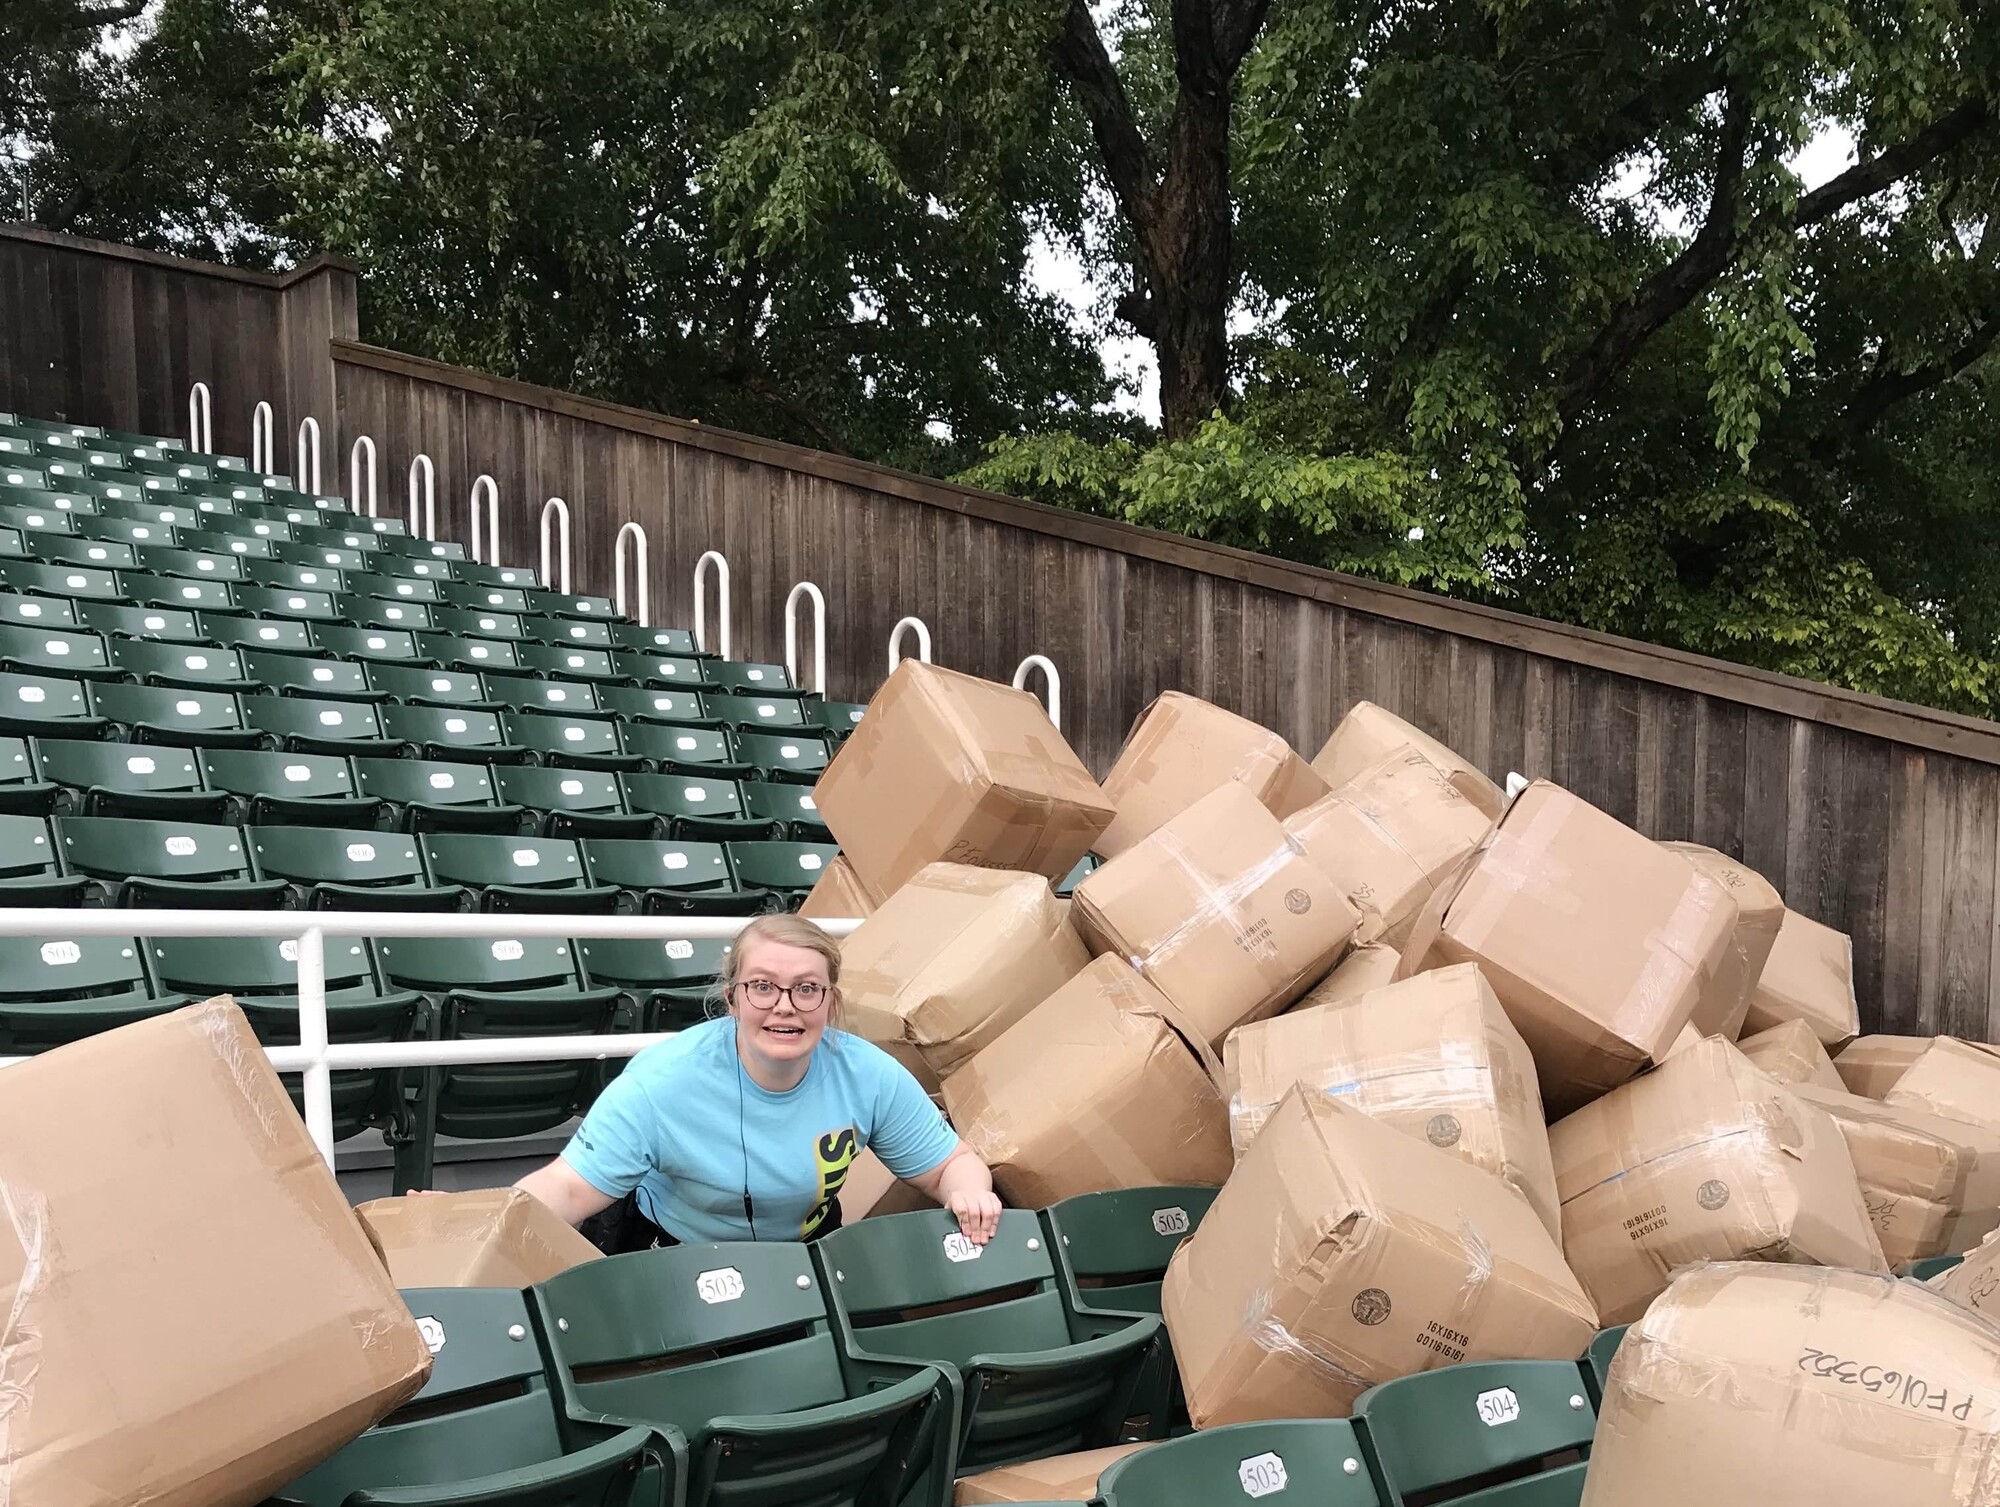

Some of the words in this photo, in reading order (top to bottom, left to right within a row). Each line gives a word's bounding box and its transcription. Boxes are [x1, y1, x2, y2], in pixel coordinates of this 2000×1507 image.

[47, 945, 74, 959] 504
[669, 943, 689, 956] 507
[1158, 1213, 1184, 1232] 505
[1630, 1217, 1669, 1241] 16X16X16
[704, 1274, 738, 1300] 503
[1427, 1320, 1469, 1347] 16X16X16
[1416, 1333, 1465, 1362] 0011616161
[1483, 1395, 1514, 1422] 504
[1247, 1462, 1281, 1494] 503
